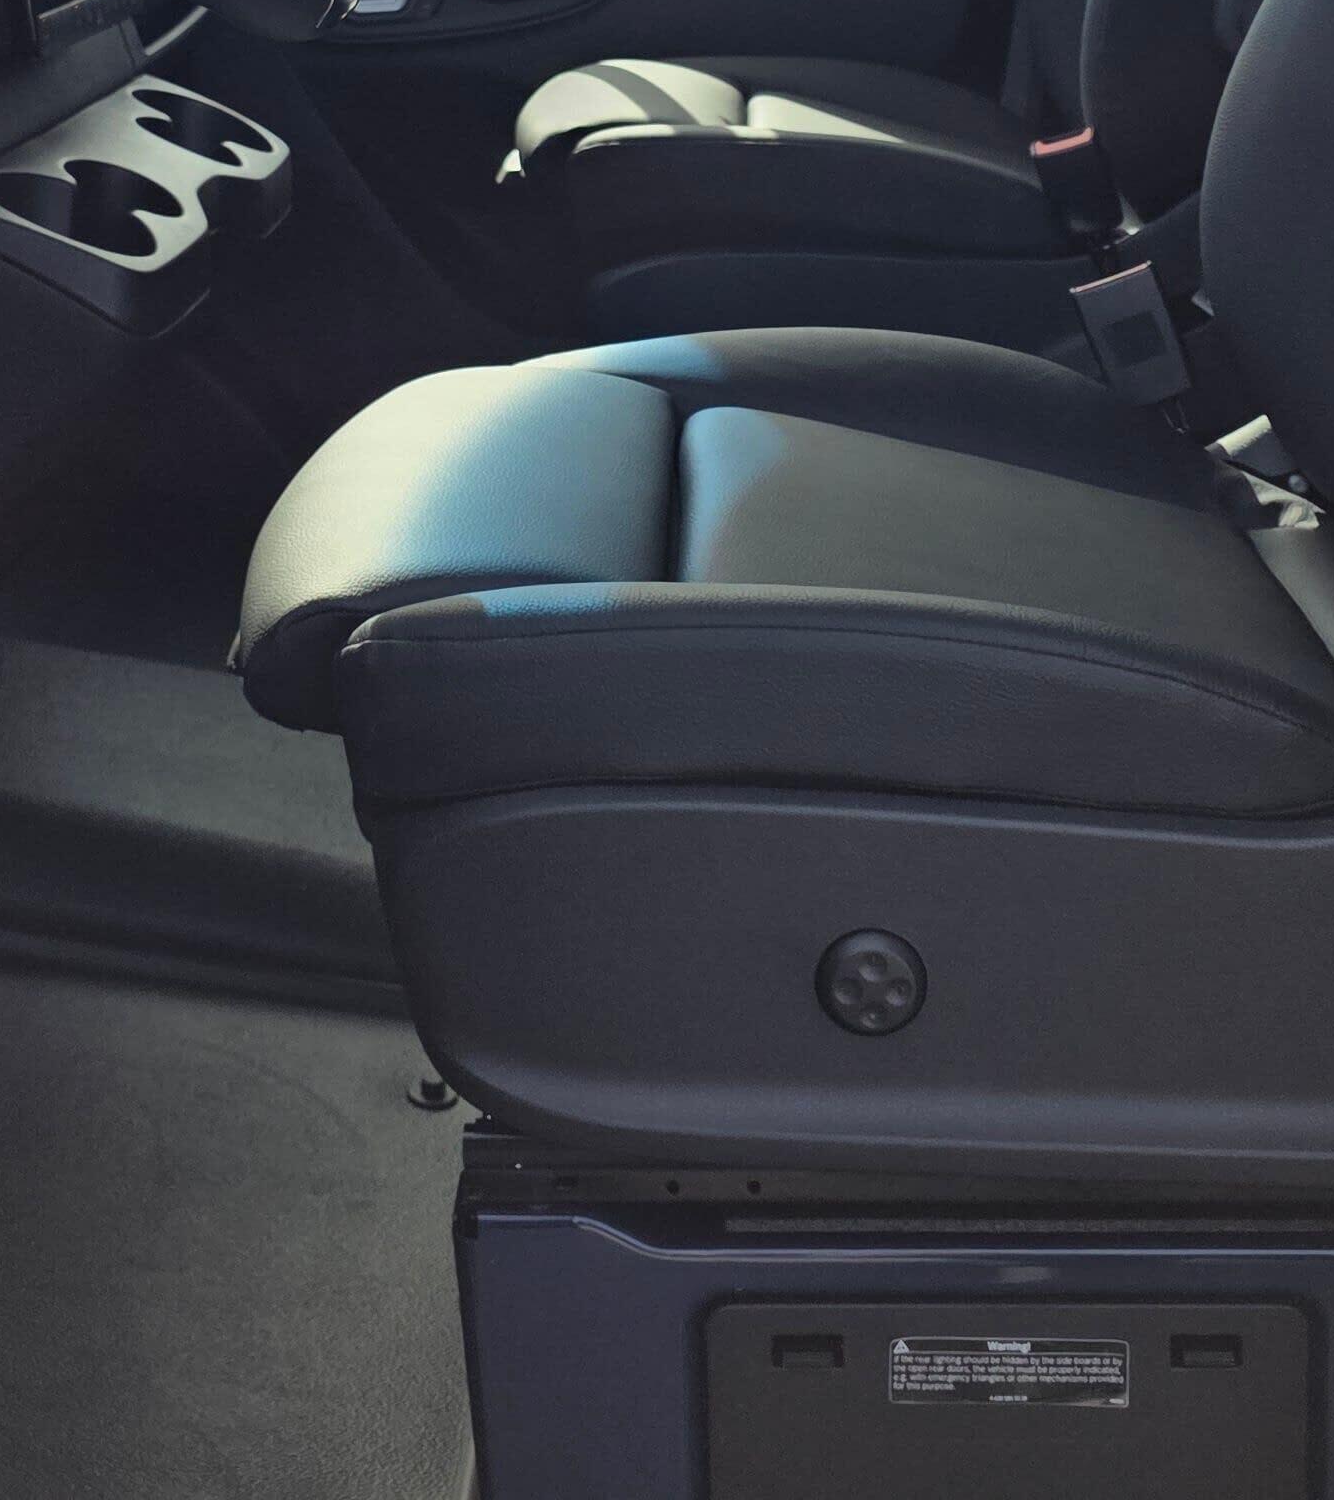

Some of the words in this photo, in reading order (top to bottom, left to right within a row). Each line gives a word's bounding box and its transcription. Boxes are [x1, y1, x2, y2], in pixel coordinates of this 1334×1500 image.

[987, 1341, 1030, 1353] Warning!
[900, 1355, 913, 1363] the
[932, 1355, 961, 1365] lighting
[990, 1356, 1000, 1364] be
[1001, 1356, 1028, 1364] hidden
[1030, 1356, 1040, 1365] by
[1041, 1356, 1054, 1364] the
[1056, 1356, 1072, 1364] side
[1112, 1356, 1122, 1365] by
[927, 1374, 970, 1382] emergency
[972, 1374, 1005, 1383] triangles
[1038, 1375, 1088, 1383] mechanisms
